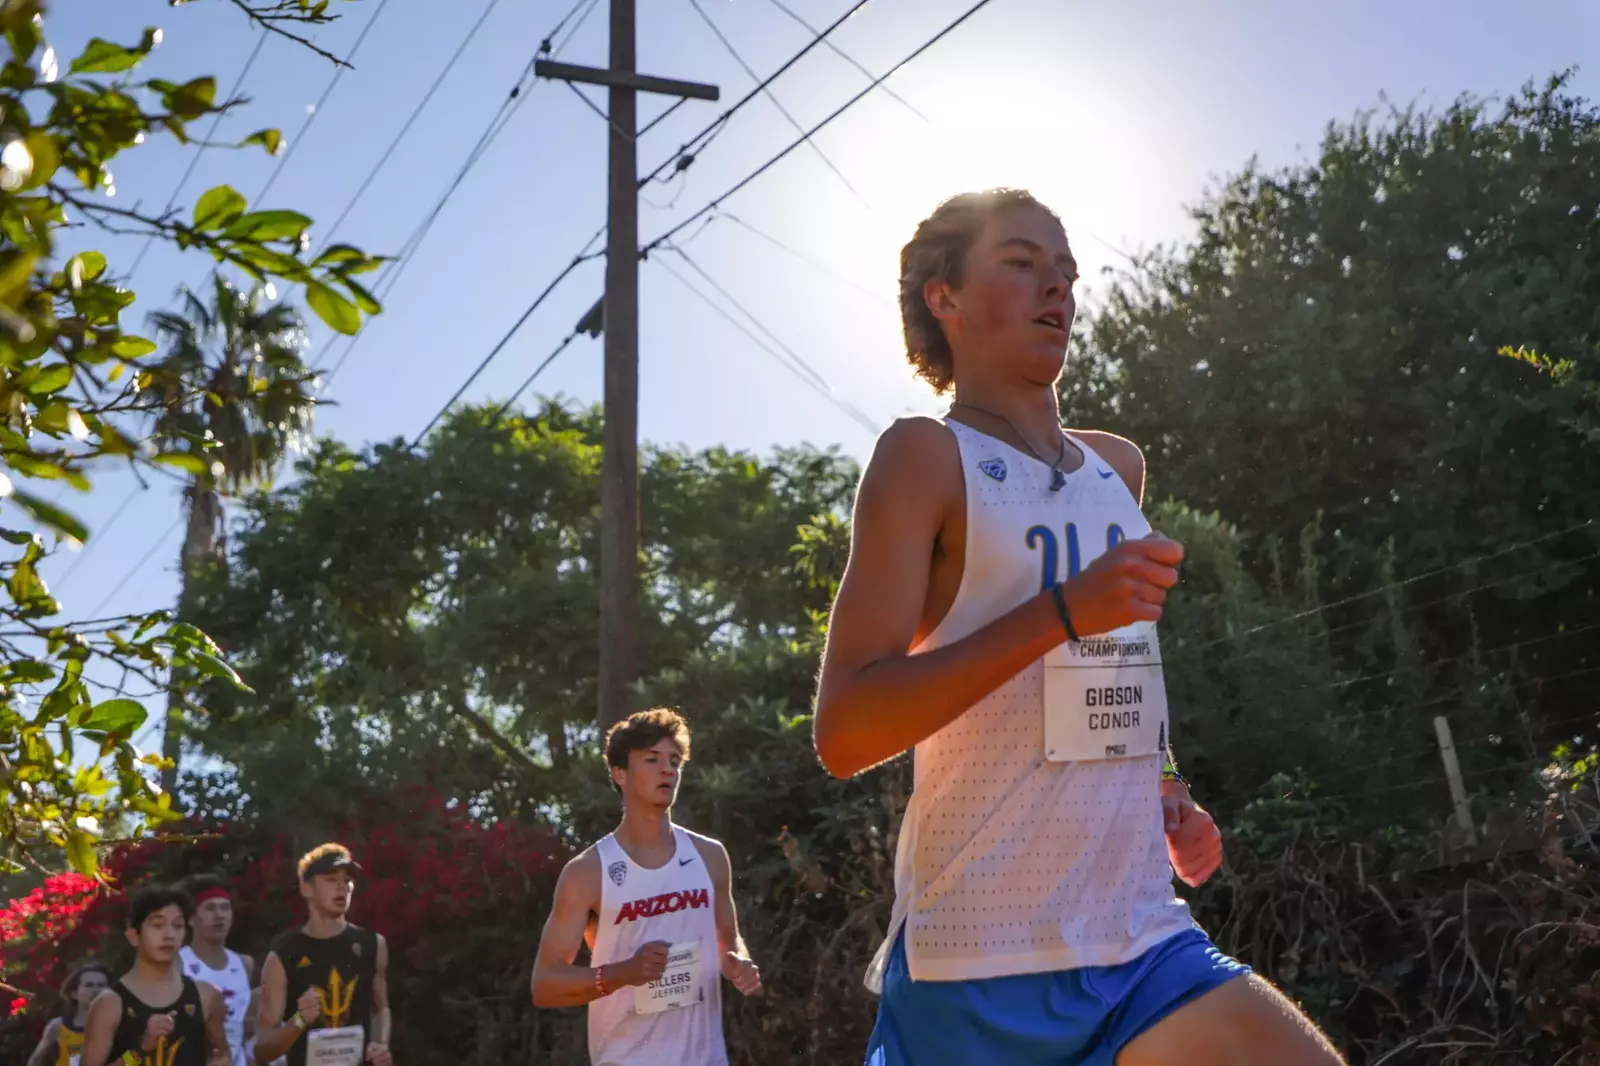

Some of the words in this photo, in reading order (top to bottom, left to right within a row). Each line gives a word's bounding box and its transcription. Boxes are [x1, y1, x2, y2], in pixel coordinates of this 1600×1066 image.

[1080, 641, 1151, 658] CHAMPIONSHIPS
[1086, 685, 1142, 706] GIBSON
[1088, 710, 1140, 730] CONOR
[614, 888, 709, 925] ARIZONA
[648, 971, 691, 989] SILLERS
[652, 985, 690, 999] JEFFREY
